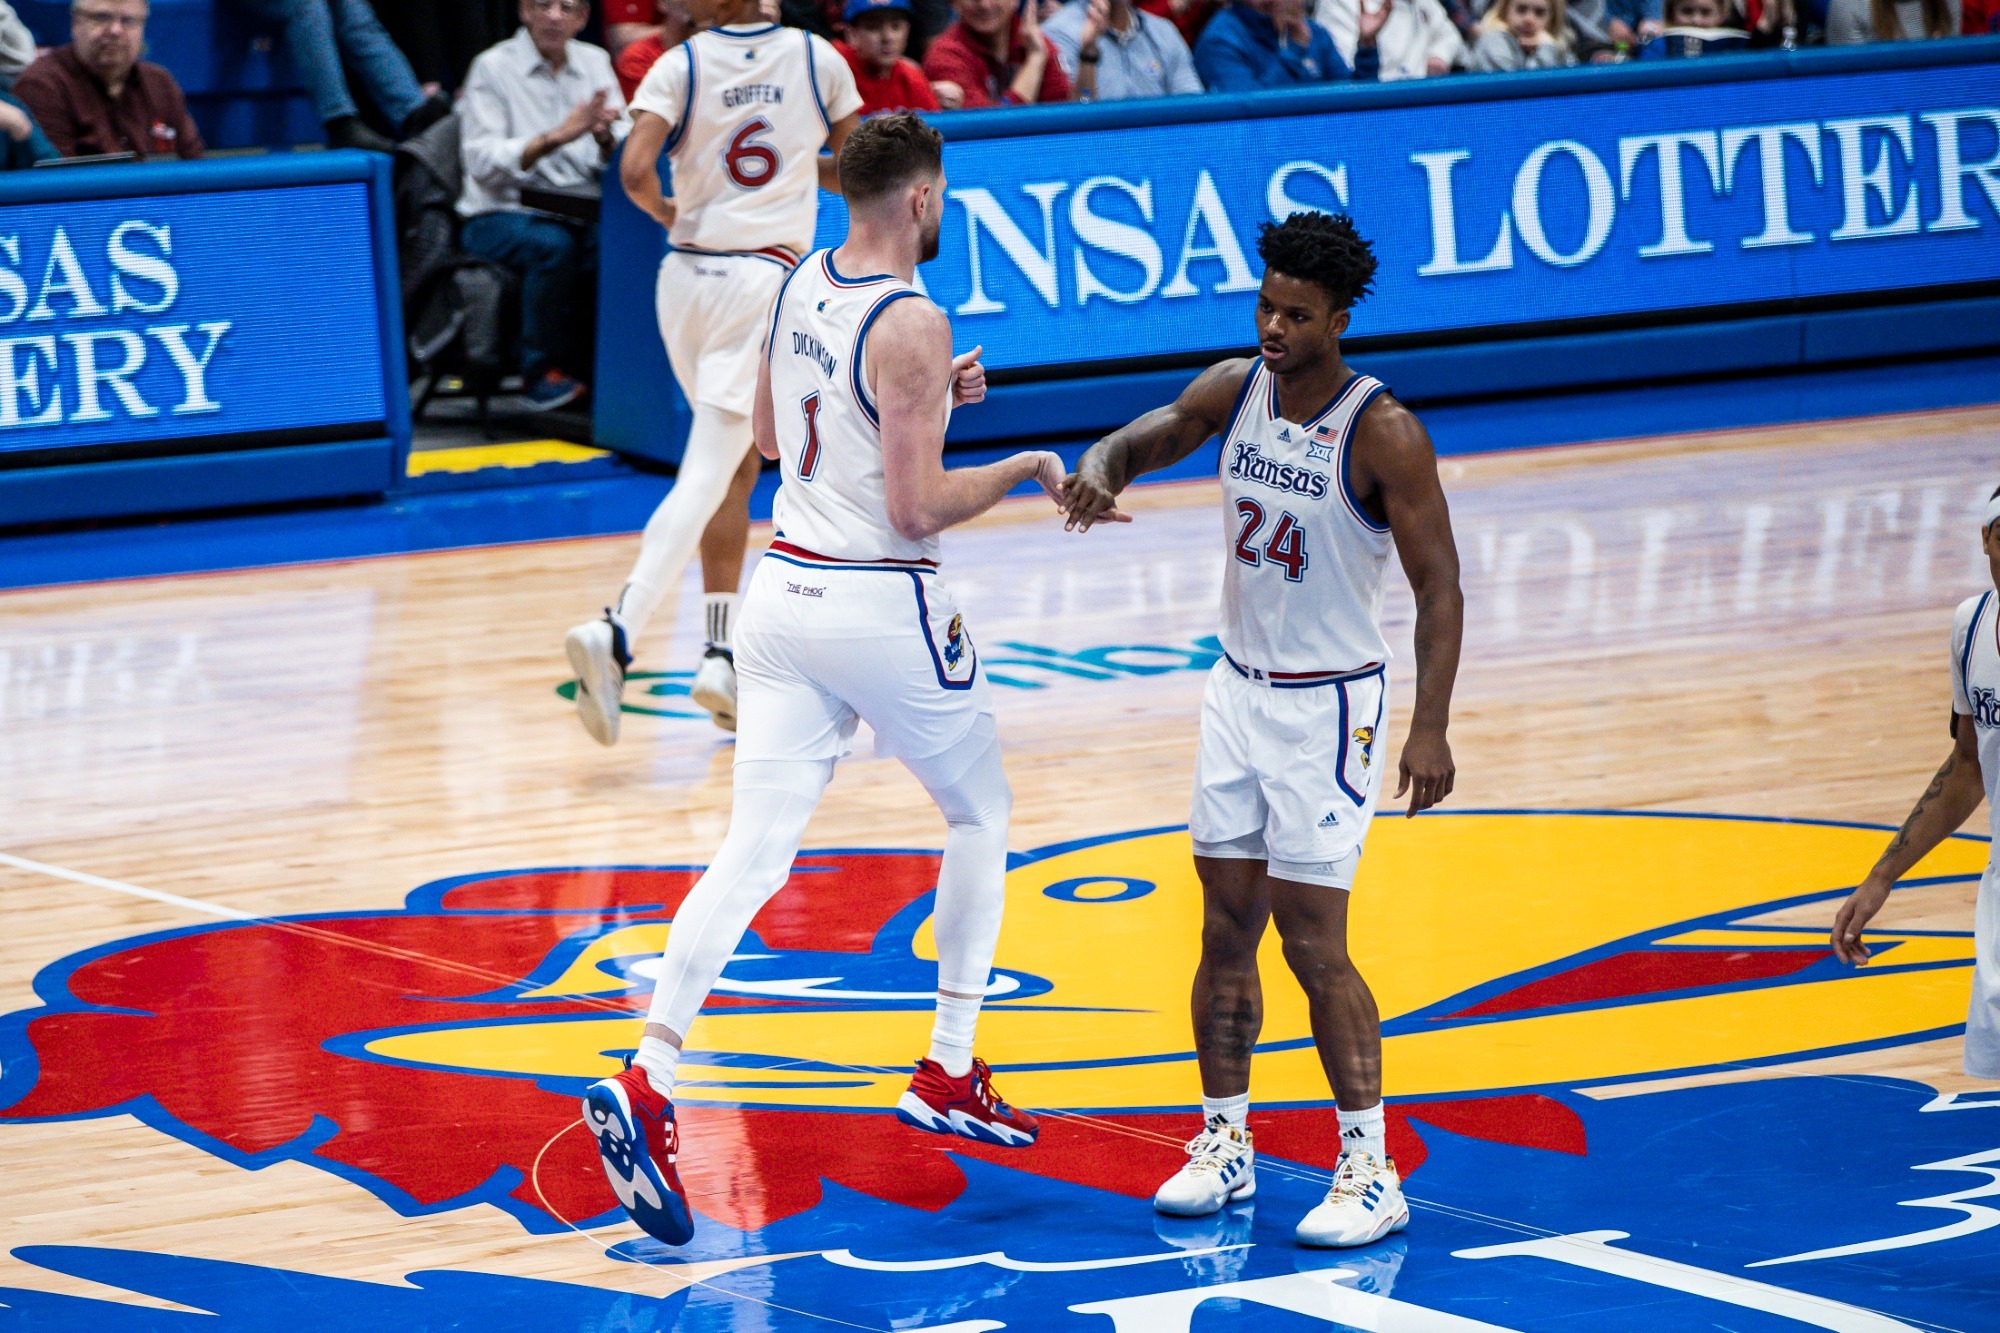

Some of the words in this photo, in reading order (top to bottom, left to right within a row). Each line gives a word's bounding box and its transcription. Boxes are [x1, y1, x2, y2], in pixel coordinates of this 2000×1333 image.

[722, 84, 783, 107] GRIFFEN
[721, 115, 783, 191] 6
[918, 160, 1350, 316] NSA
[1409, 108, 2000, 276] LOTTER
[0, 321, 233, 430] ERY
[792, 331, 837, 380] DICKINSON
[797, 389, 821, 482] 1
[1229, 440, 1330, 500] Kansas
[1235, 497, 1308, 582] 24
